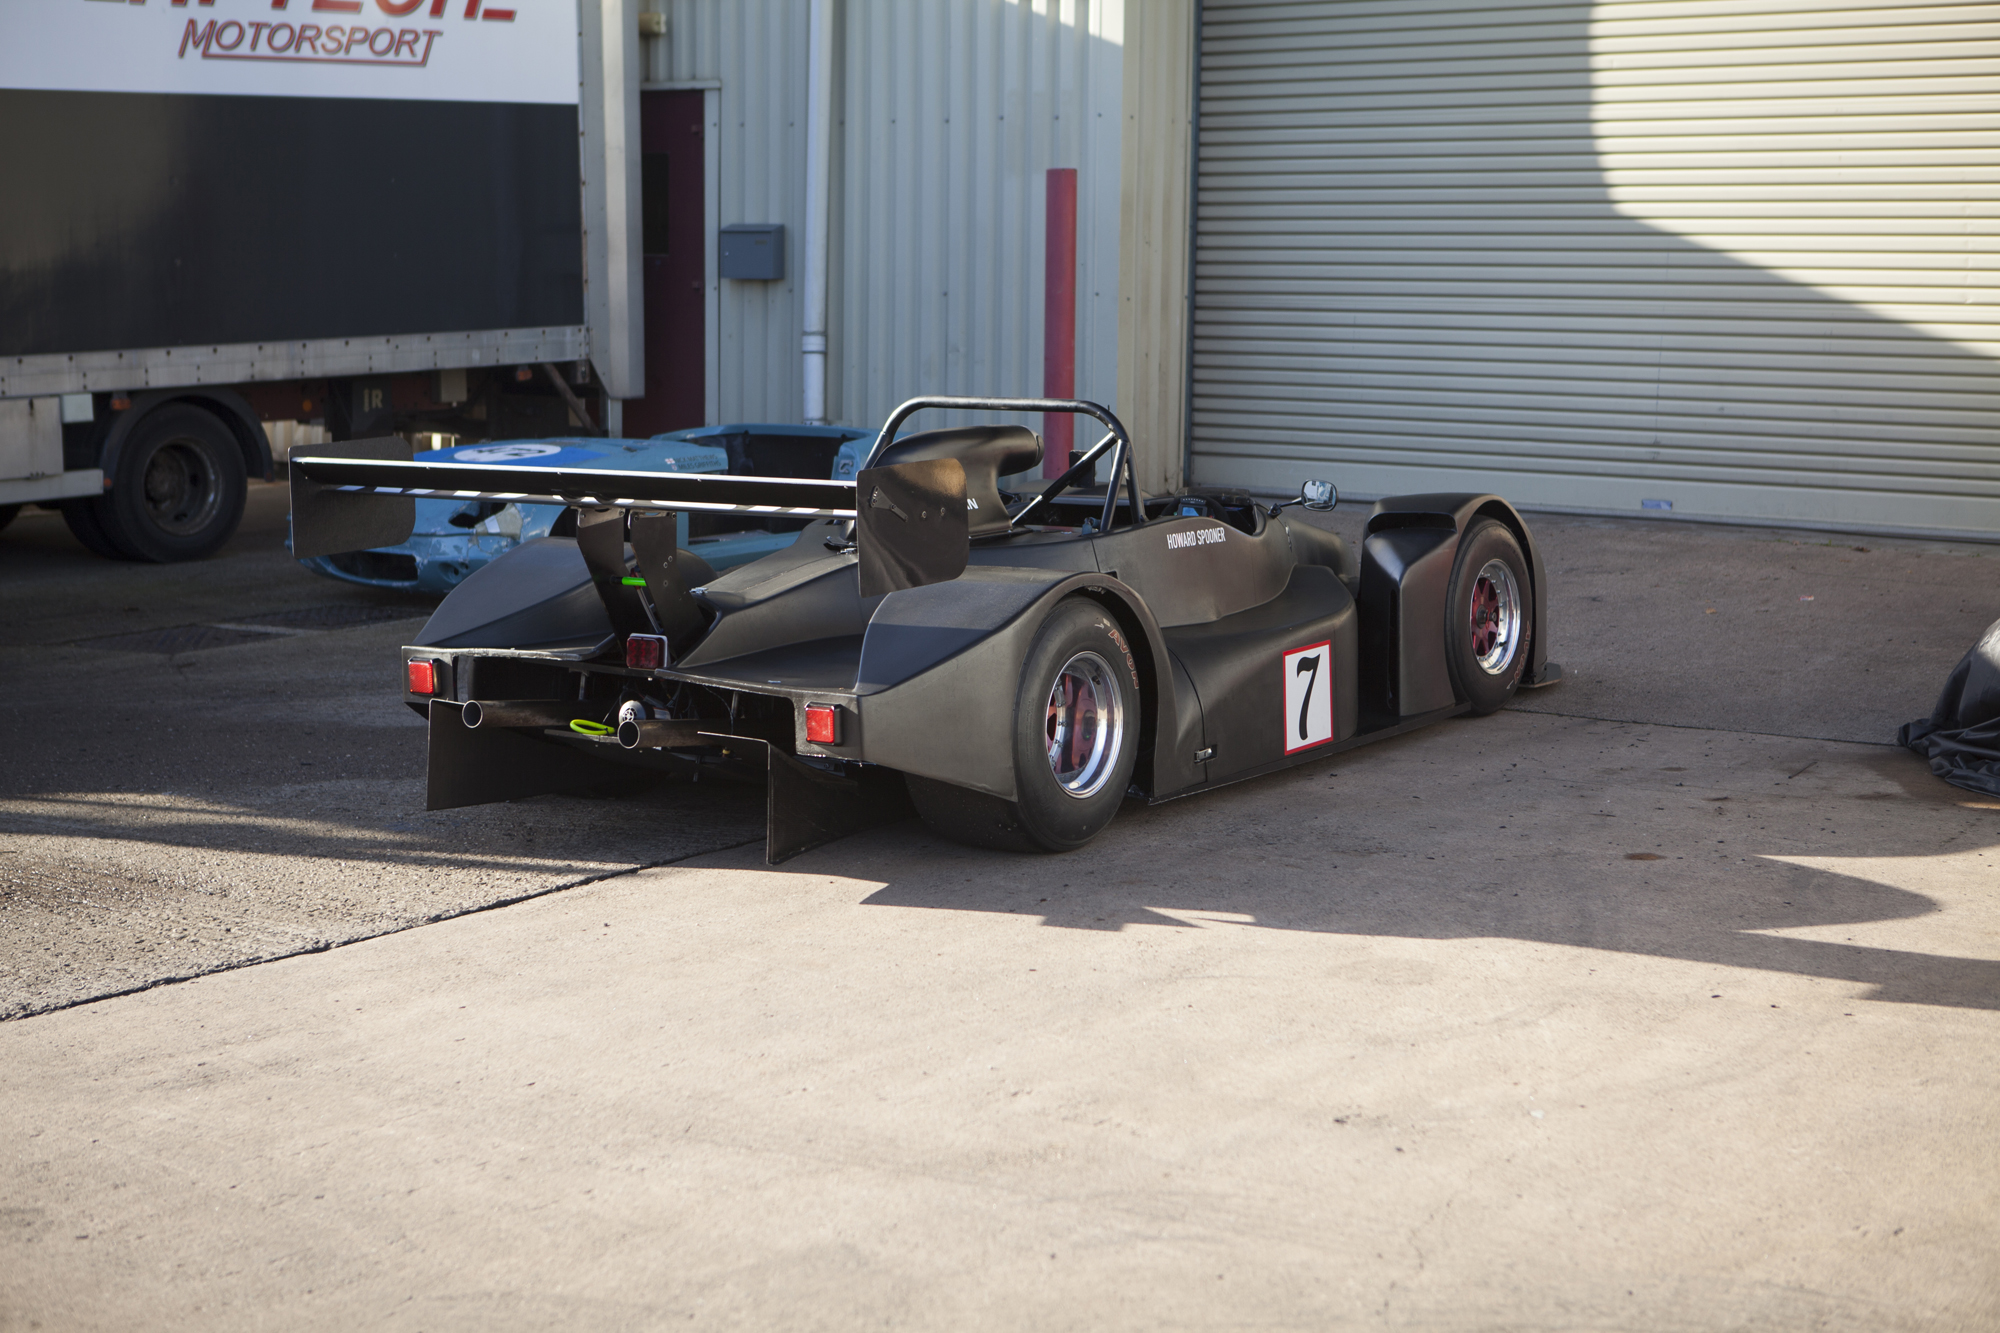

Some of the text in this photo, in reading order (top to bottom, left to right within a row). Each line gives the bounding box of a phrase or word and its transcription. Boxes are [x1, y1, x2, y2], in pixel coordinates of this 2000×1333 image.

[178, 18, 443, 66] MOTORSPORT
[1166, 527, 1226, 549] HOWARD SPOONER
[1108, 629, 1140, 690] AVON
[1514, 620, 1532, 684] AVON
[1296, 653, 1321, 741] 7
